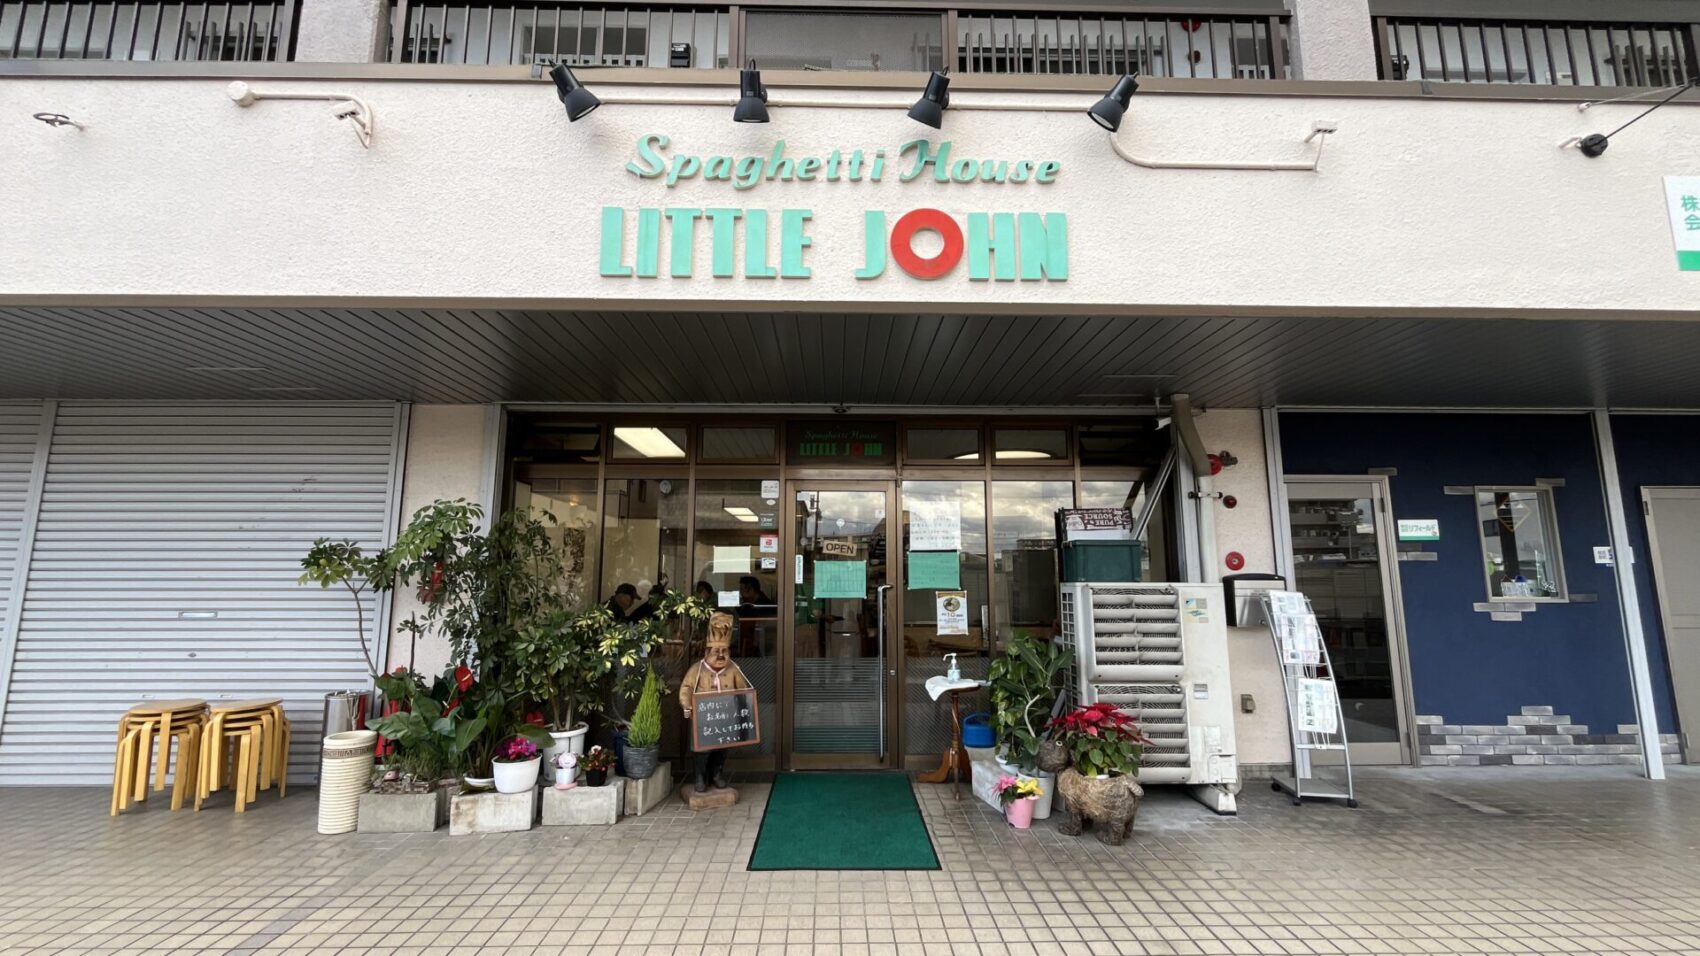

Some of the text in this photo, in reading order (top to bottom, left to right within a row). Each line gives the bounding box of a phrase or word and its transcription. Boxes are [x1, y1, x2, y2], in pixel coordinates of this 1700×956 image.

[626, 133, 1063, 190] Spaghetti House
[599, 206, 1069, 282] LITTLE JOHN
[799, 441, 883, 457] LITTLE JOHN
[825, 542, 855, 554] OPEN
